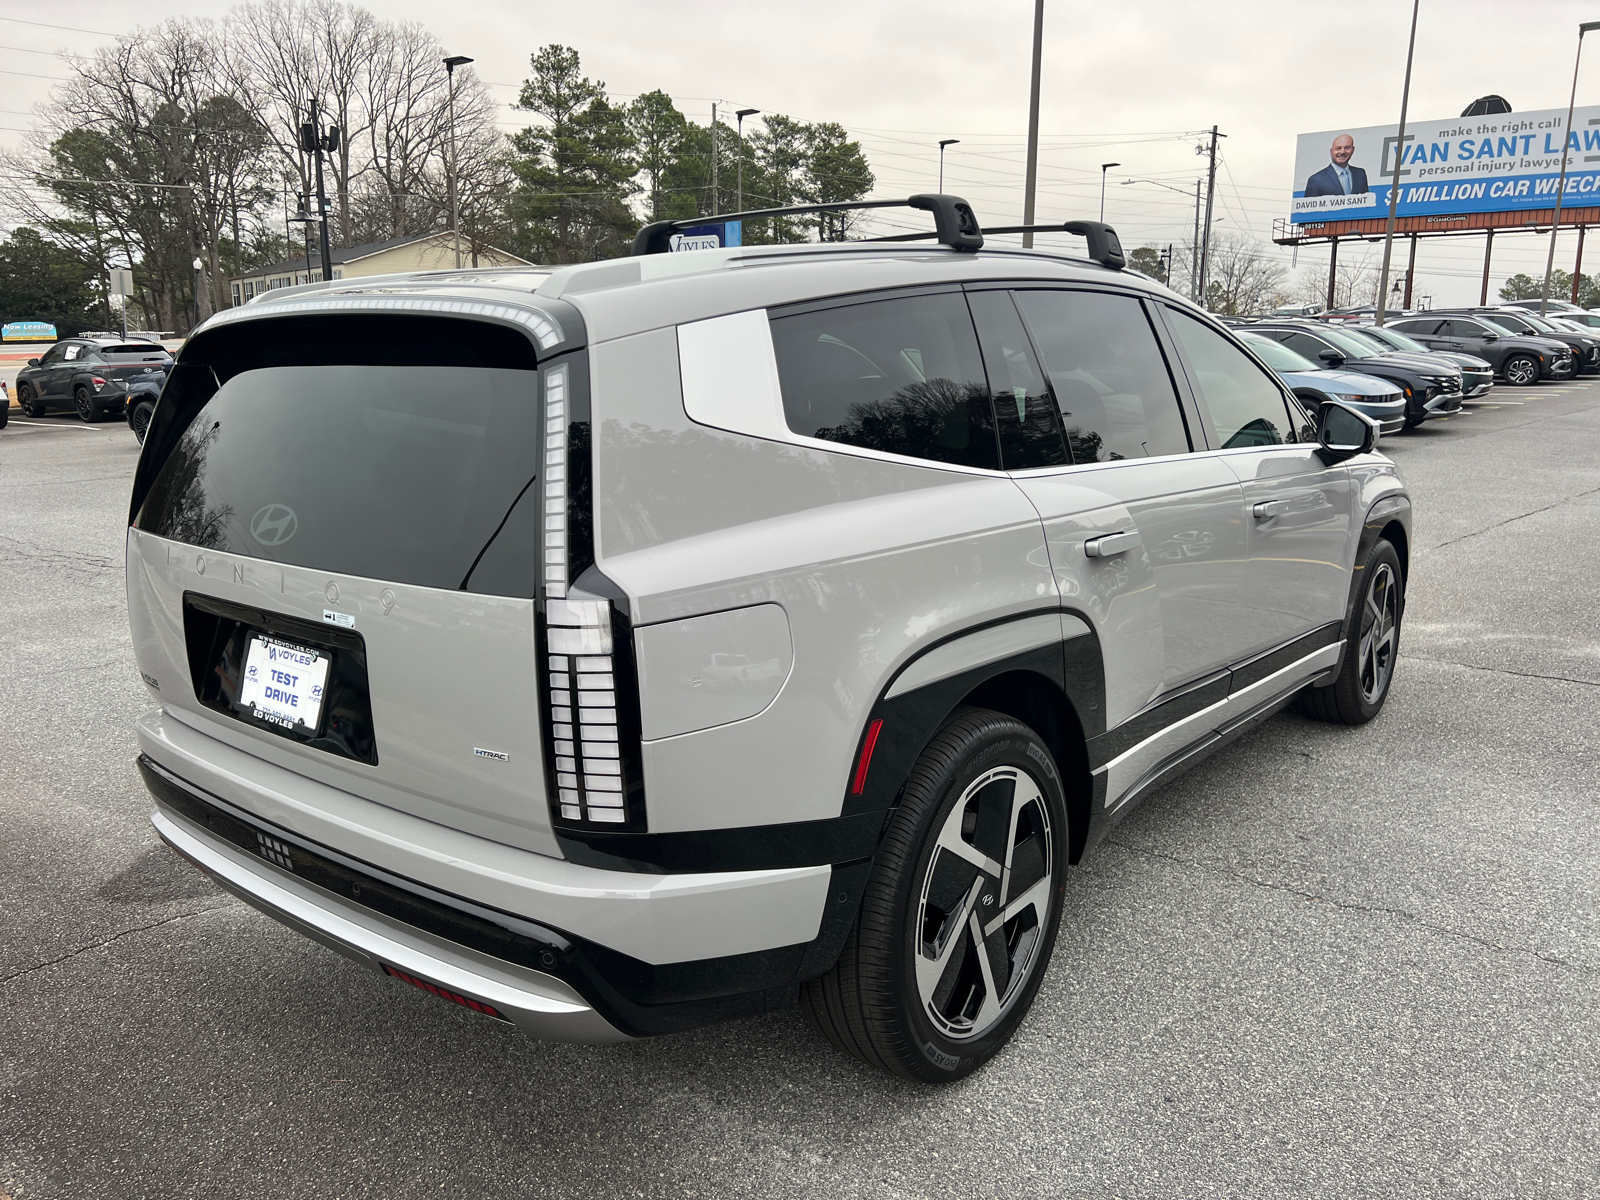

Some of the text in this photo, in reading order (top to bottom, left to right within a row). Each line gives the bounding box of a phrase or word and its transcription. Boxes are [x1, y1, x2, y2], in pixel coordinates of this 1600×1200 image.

[1438, 117, 1561, 138] make the right call
[1394, 142, 1450, 166] VAN
[1457, 134, 1537, 161] SANT
[1418, 161, 1474, 178] personal
[1477, 160, 1516, 173] injury
[1406, 182, 1487, 203] MILLION
[1489, 179, 1531, 198] CAR
[1296, 196, 1368, 210] DAVID M. VAN SANT
[165, 545, 396, 618] IONIQ 9
[278, 648, 311, 666] VOYLES
[270, 669, 299, 687] TEST
[264, 686, 299, 707] DRIVE
[253, 709, 294, 730] ED VOYLES
[475, 749, 506, 760] HTRAC
